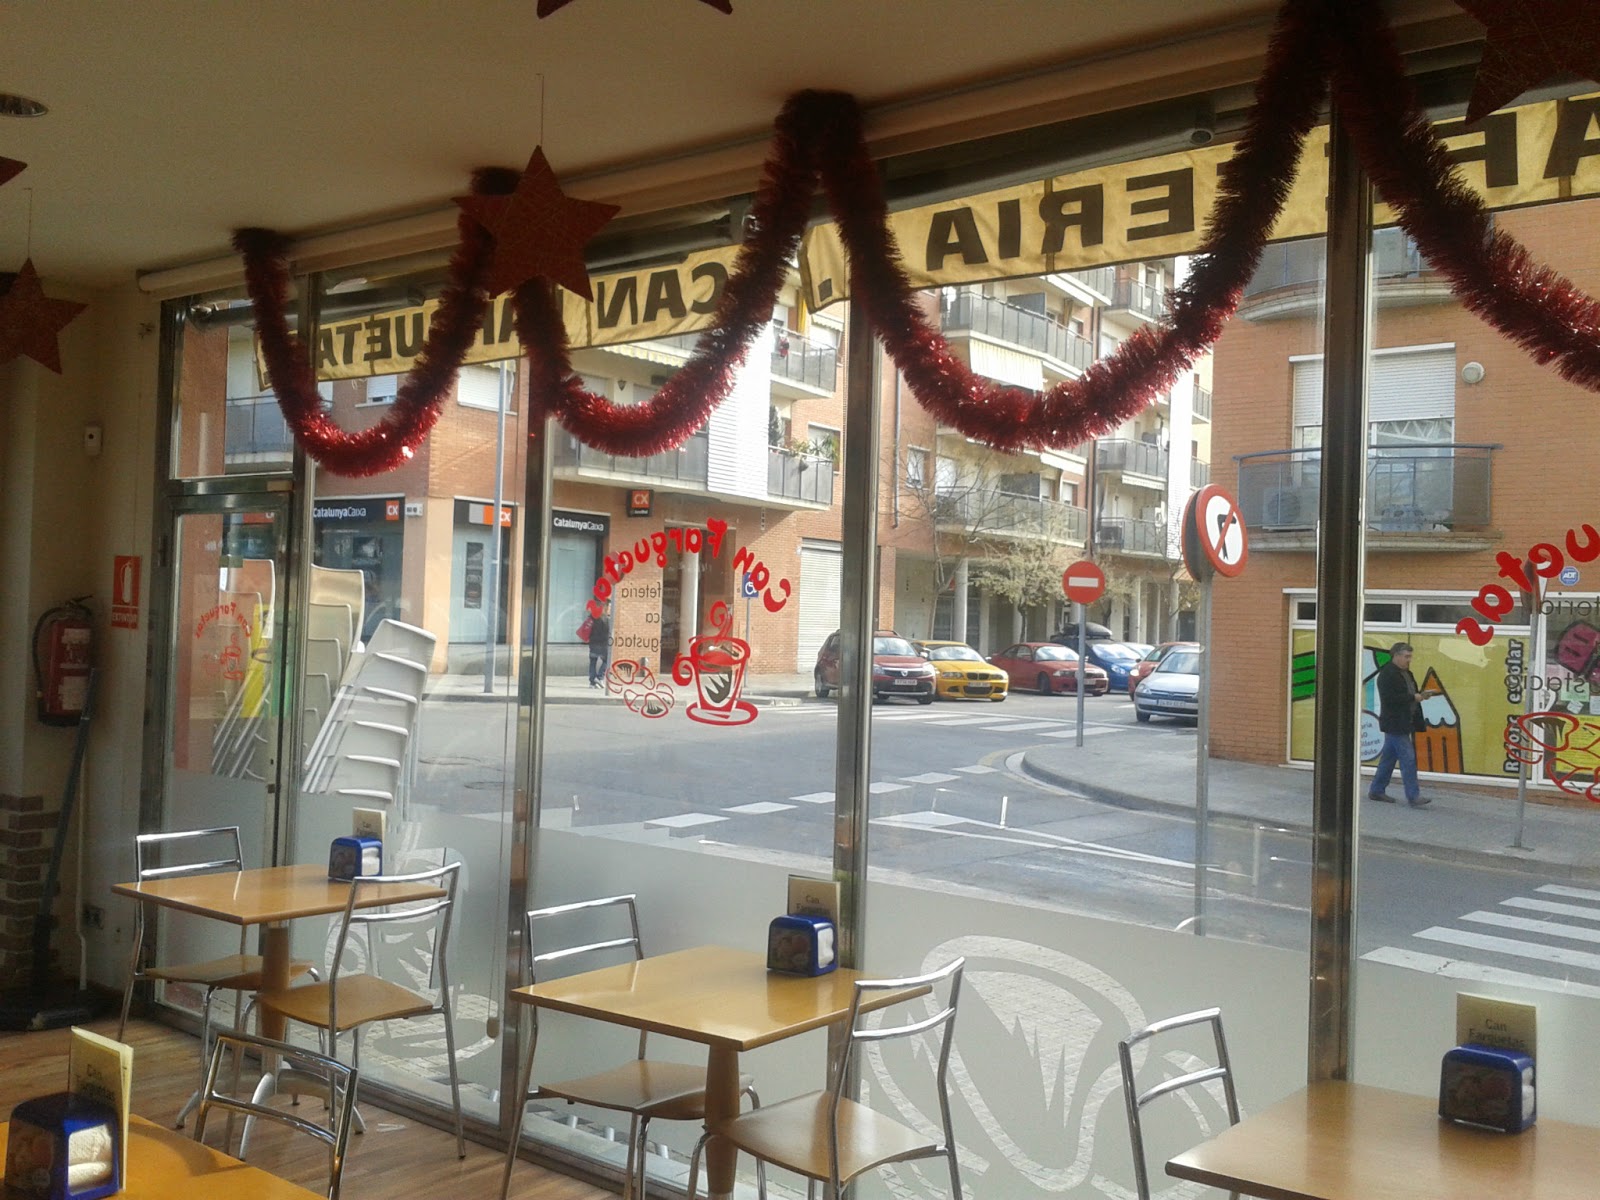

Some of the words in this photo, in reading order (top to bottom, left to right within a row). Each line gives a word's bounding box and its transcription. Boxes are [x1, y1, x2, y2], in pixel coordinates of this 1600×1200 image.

[634, 493, 649, 505] CX
[313, 507, 367, 519] CatalunyaCaixa
[387, 505, 399, 516] CX
[553, 517, 604, 531] CatalunyaCaixa
[1485, 1018, 1508, 1032] Can
